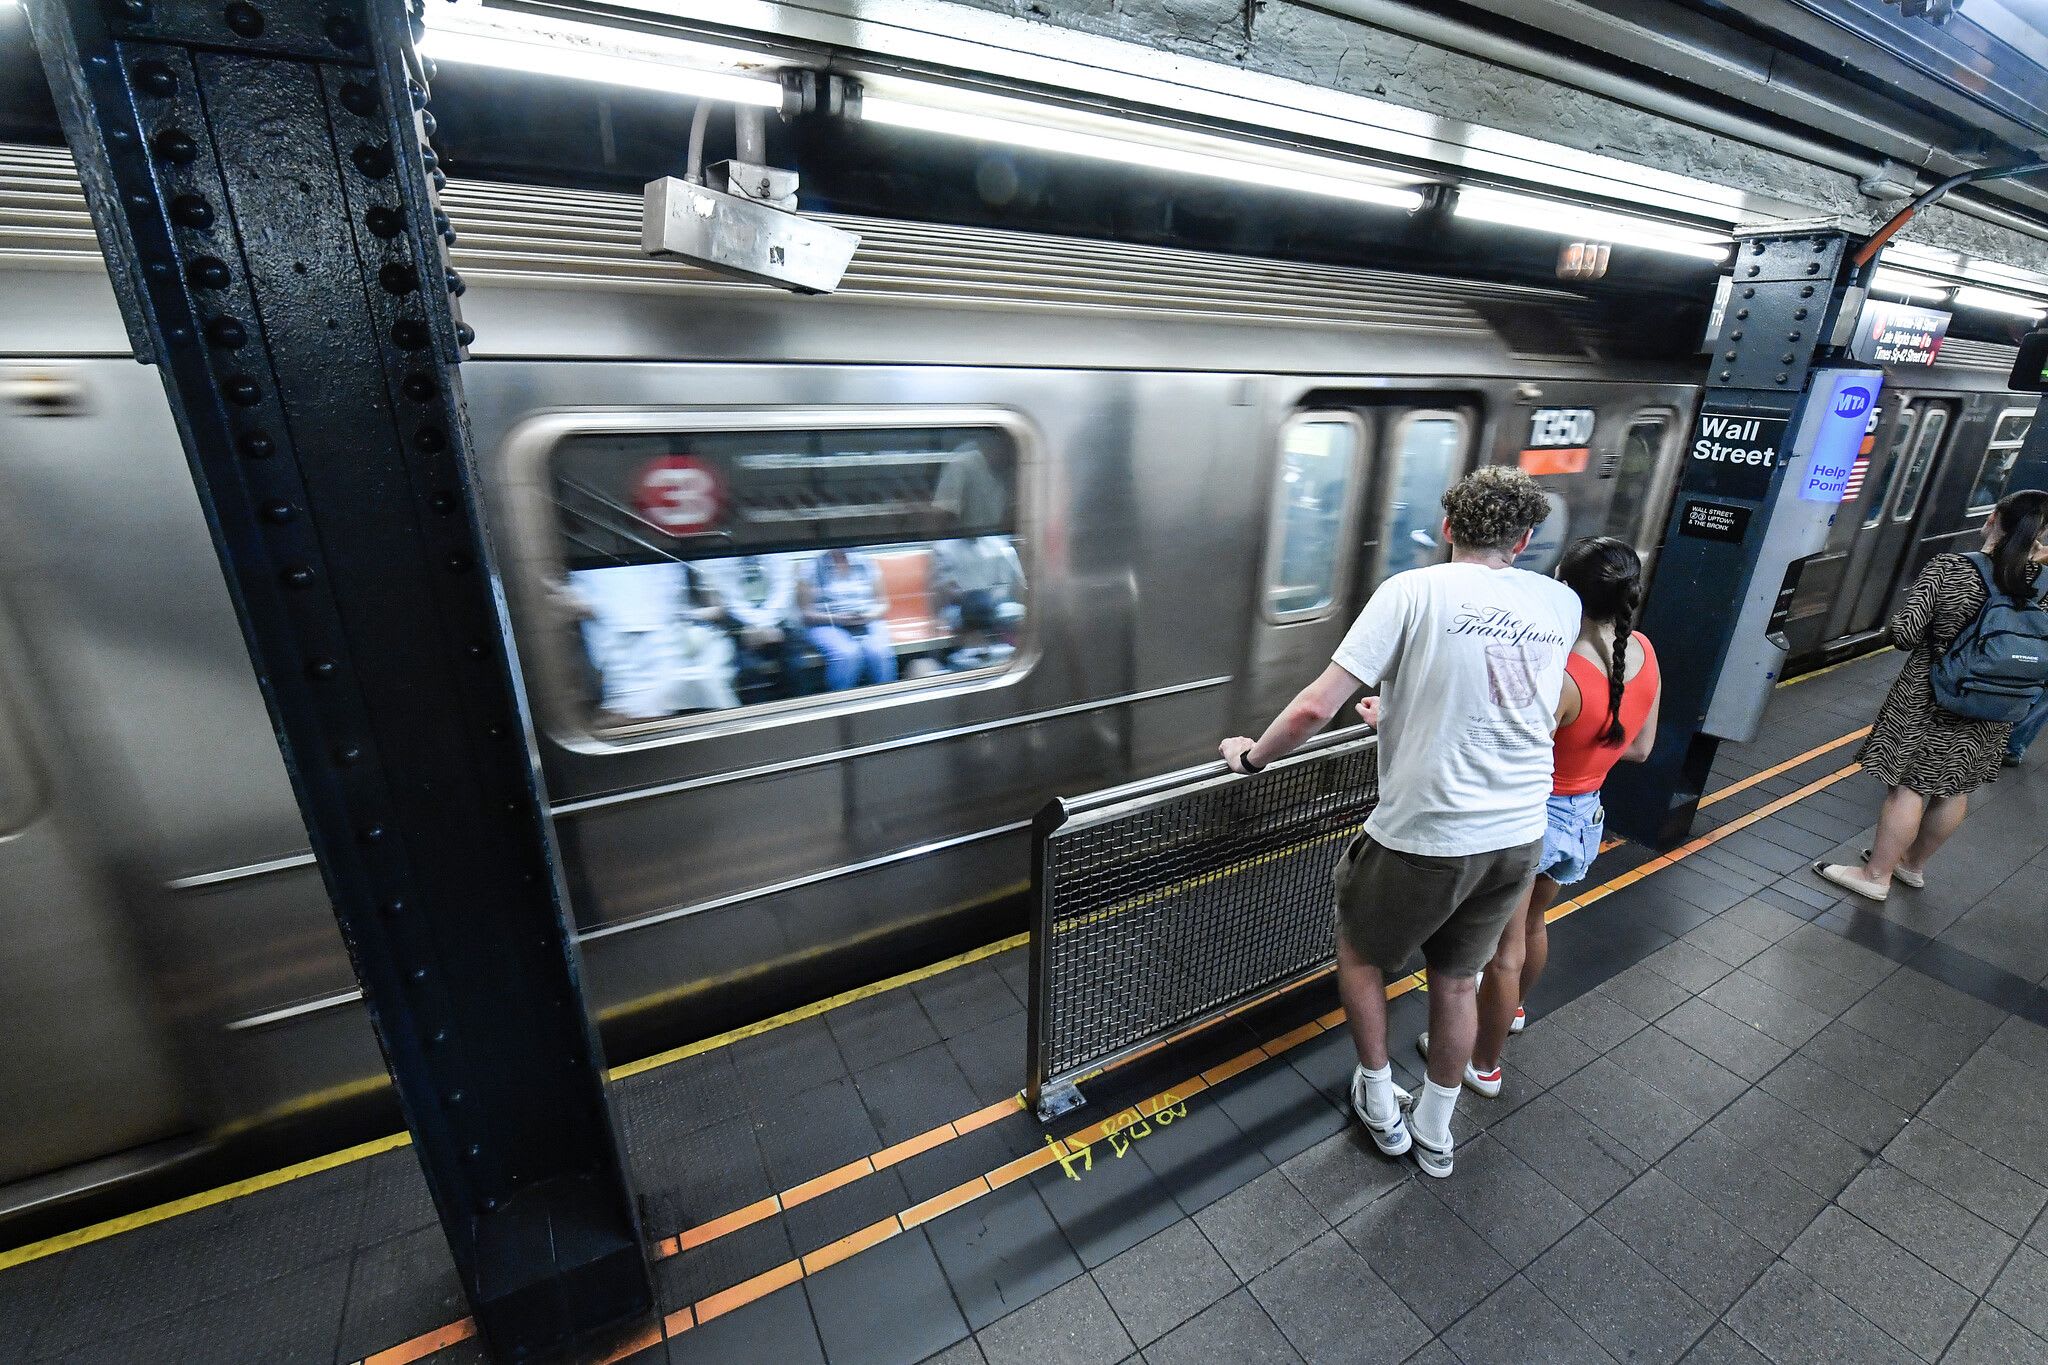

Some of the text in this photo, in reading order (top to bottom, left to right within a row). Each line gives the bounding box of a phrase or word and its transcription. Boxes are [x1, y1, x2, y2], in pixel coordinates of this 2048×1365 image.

[1835, 393, 1865, 411] MTA
[1702, 417, 1760, 441] Wall
[1692, 440, 1775, 467] Street
[1813, 464, 1846, 480] Help
[1808, 479, 1846, 492] Point
[642, 467, 719, 526] 3
[1692, 506, 1734, 518] WALL STREET
[1707, 515, 1736, 525] UPTOWN
[1706, 522, 1730, 531] BRONX
[1476, 606, 1523, 628] The
